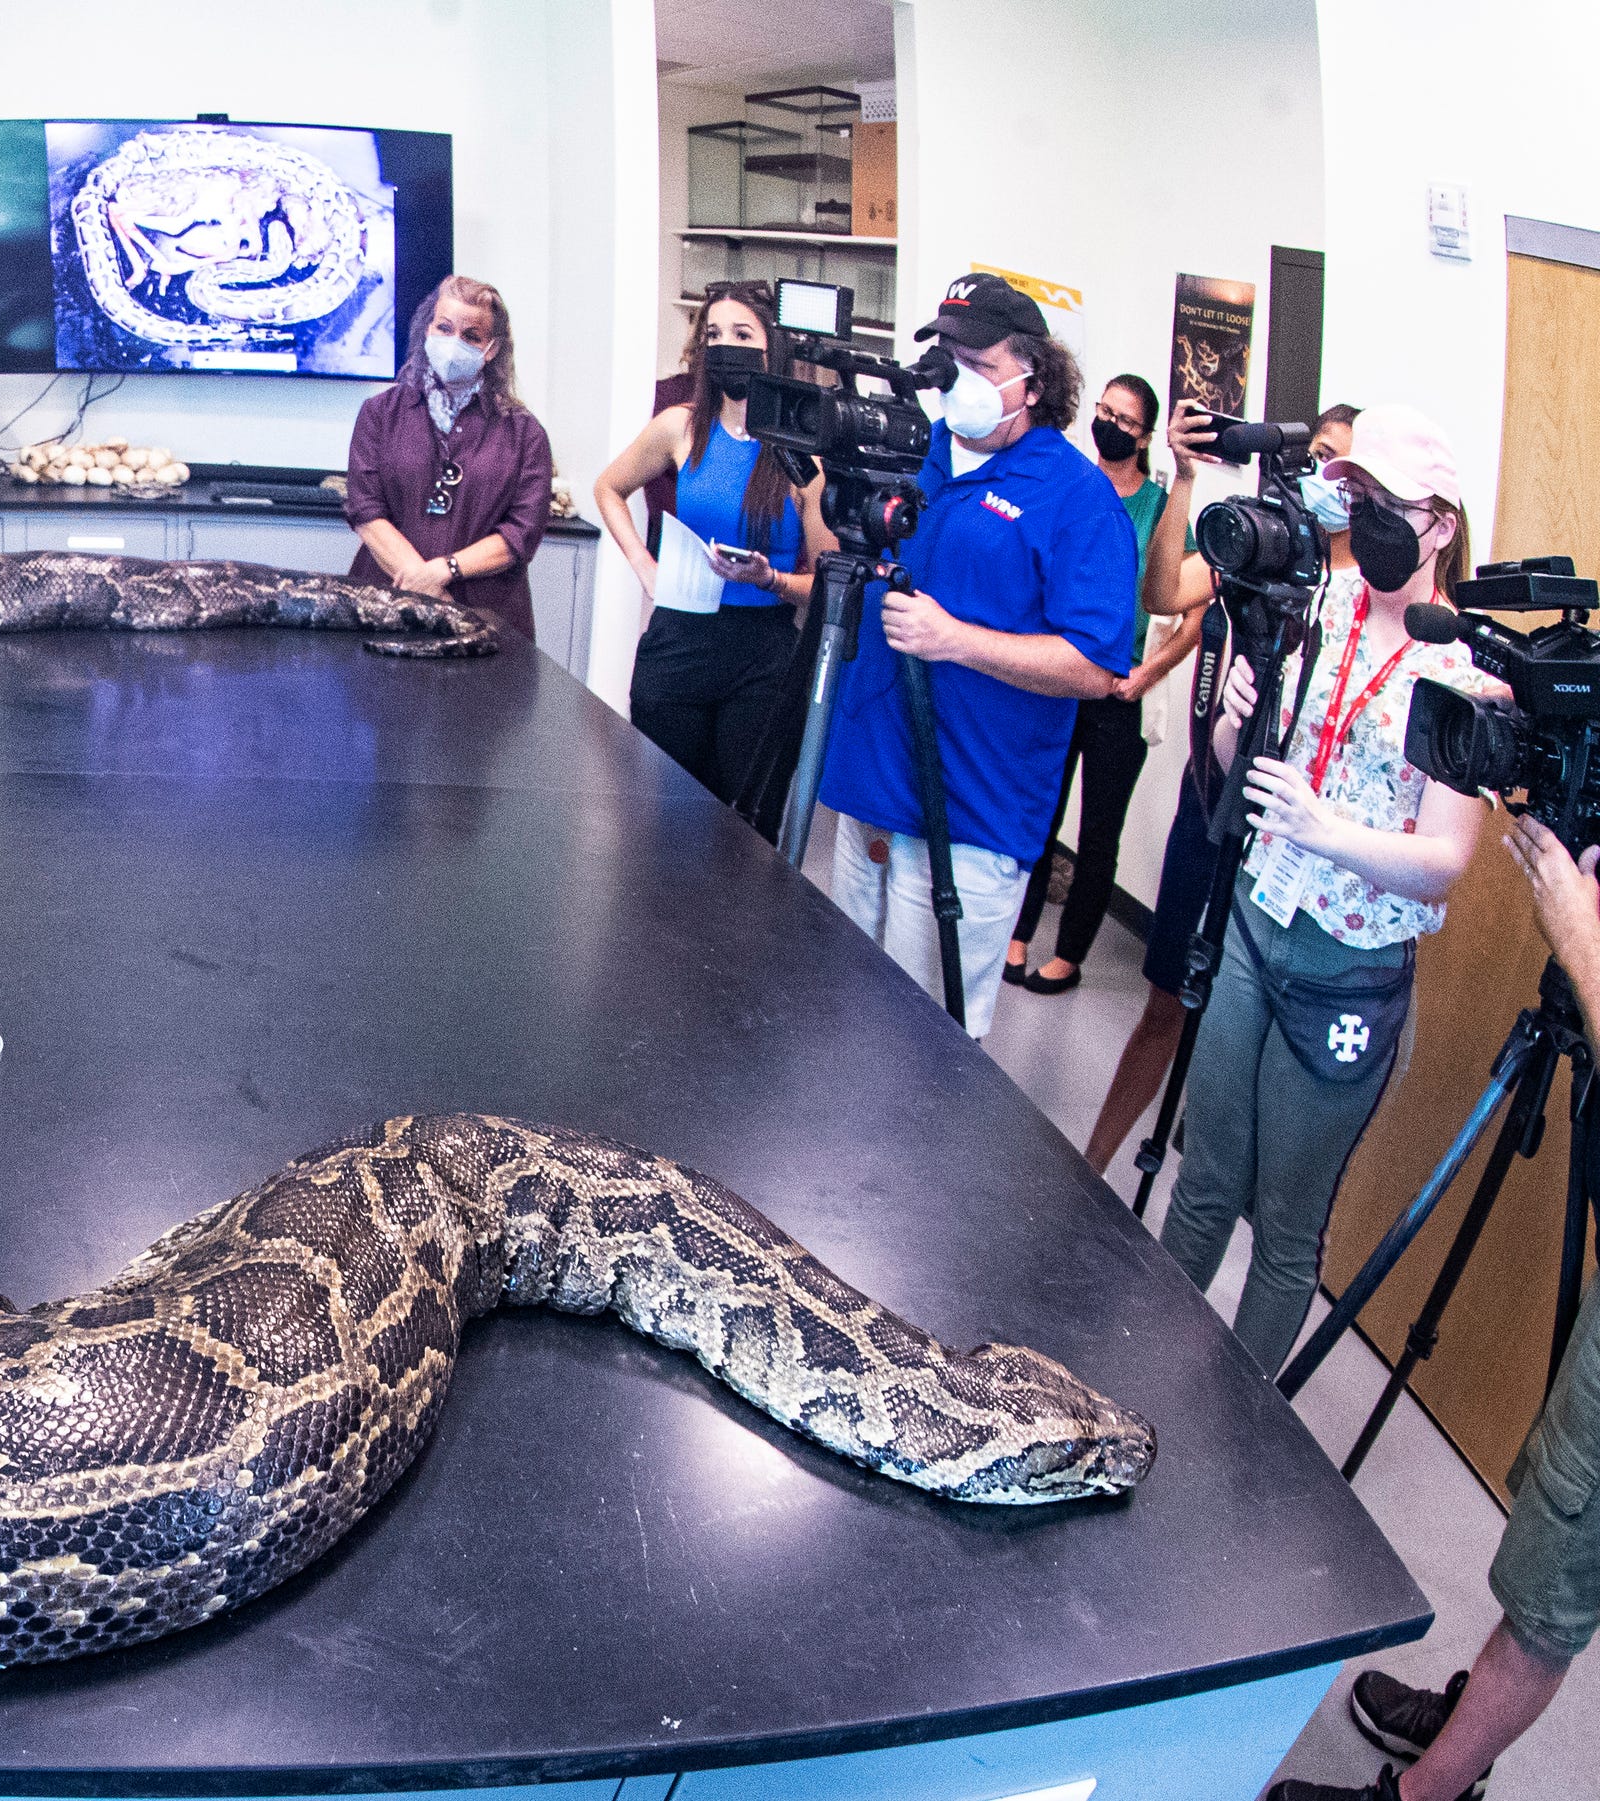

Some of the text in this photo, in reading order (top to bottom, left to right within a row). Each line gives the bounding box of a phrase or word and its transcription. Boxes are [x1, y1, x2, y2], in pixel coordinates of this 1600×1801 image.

[948, 281, 978, 300] W
[1179, 302, 1203, 317] DON'T
[1203, 308, 1216, 320] LET
[1216, 310, 1225, 322] IT
[1194, 651, 1216, 718] Canon
[1553, 683, 1591, 693] XDCAM
